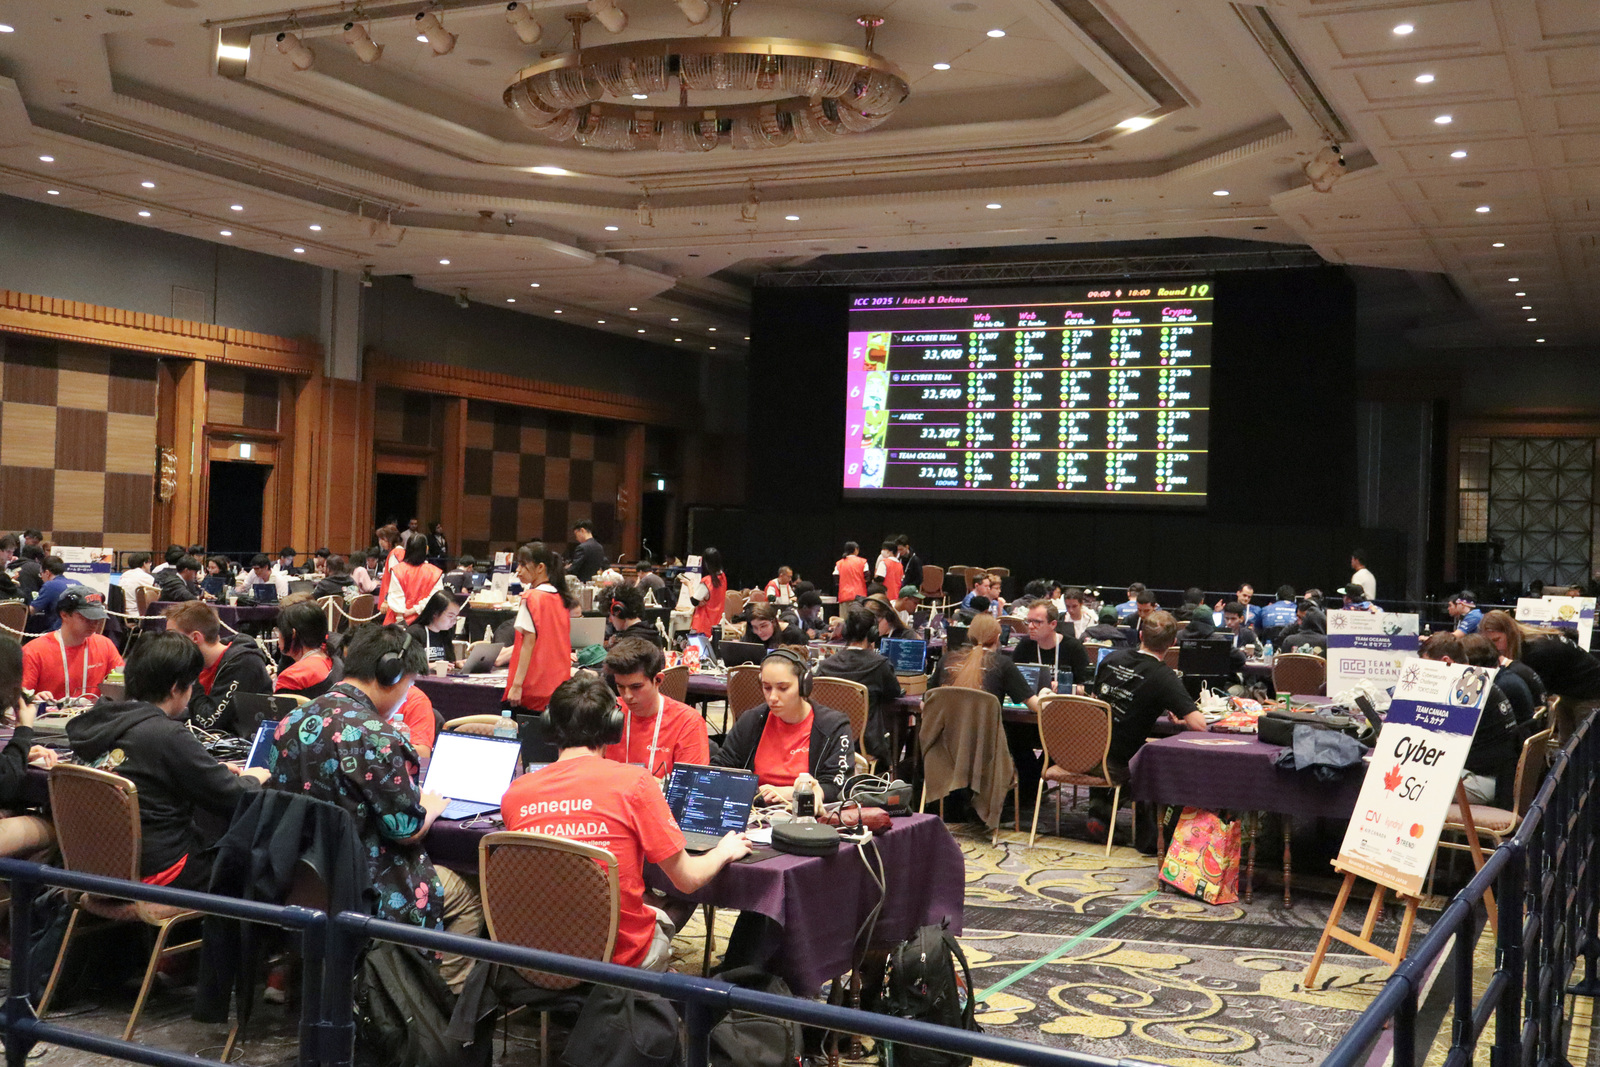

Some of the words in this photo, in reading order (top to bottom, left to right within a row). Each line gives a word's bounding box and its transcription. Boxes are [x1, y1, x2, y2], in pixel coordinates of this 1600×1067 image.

[1157, 288, 1187, 297] Round
[1189, 285, 1209, 297] 19
[854, 298, 869, 306] ICC
[871, 297, 893, 305] 2025
[902, 296, 926, 304] Attack
[937, 295, 968, 304] Defense
[973, 313, 991, 321] Web
[1064, 311, 1083, 319] Pwn
[1112, 309, 1132, 317] Pwn
[1161, 307, 1192, 317] Crypto
[852, 348, 861, 358] 5
[923, 349, 963, 360] 33,908
[850, 387, 860, 397] 6
[921, 389, 962, 400] 32,590
[850, 424, 860, 436] 7
[920, 428, 961, 439] 32,287
[917, 452, 946, 460] OCEANIA
[848, 463, 858, 474] 8
[918, 467, 958, 478] 32,106
[1416, 705, 1430, 714] TEAM
[1428, 707, 1449, 718] CANADA
[1393, 736, 1446, 767] Cyber
[1398, 776, 1428, 802] Sci
[519, 798, 593, 818] seneque
[1365, 809, 1382, 824] CN
[544, 820, 610, 837] CANADA
[1400, 839, 1415, 849] TREND
